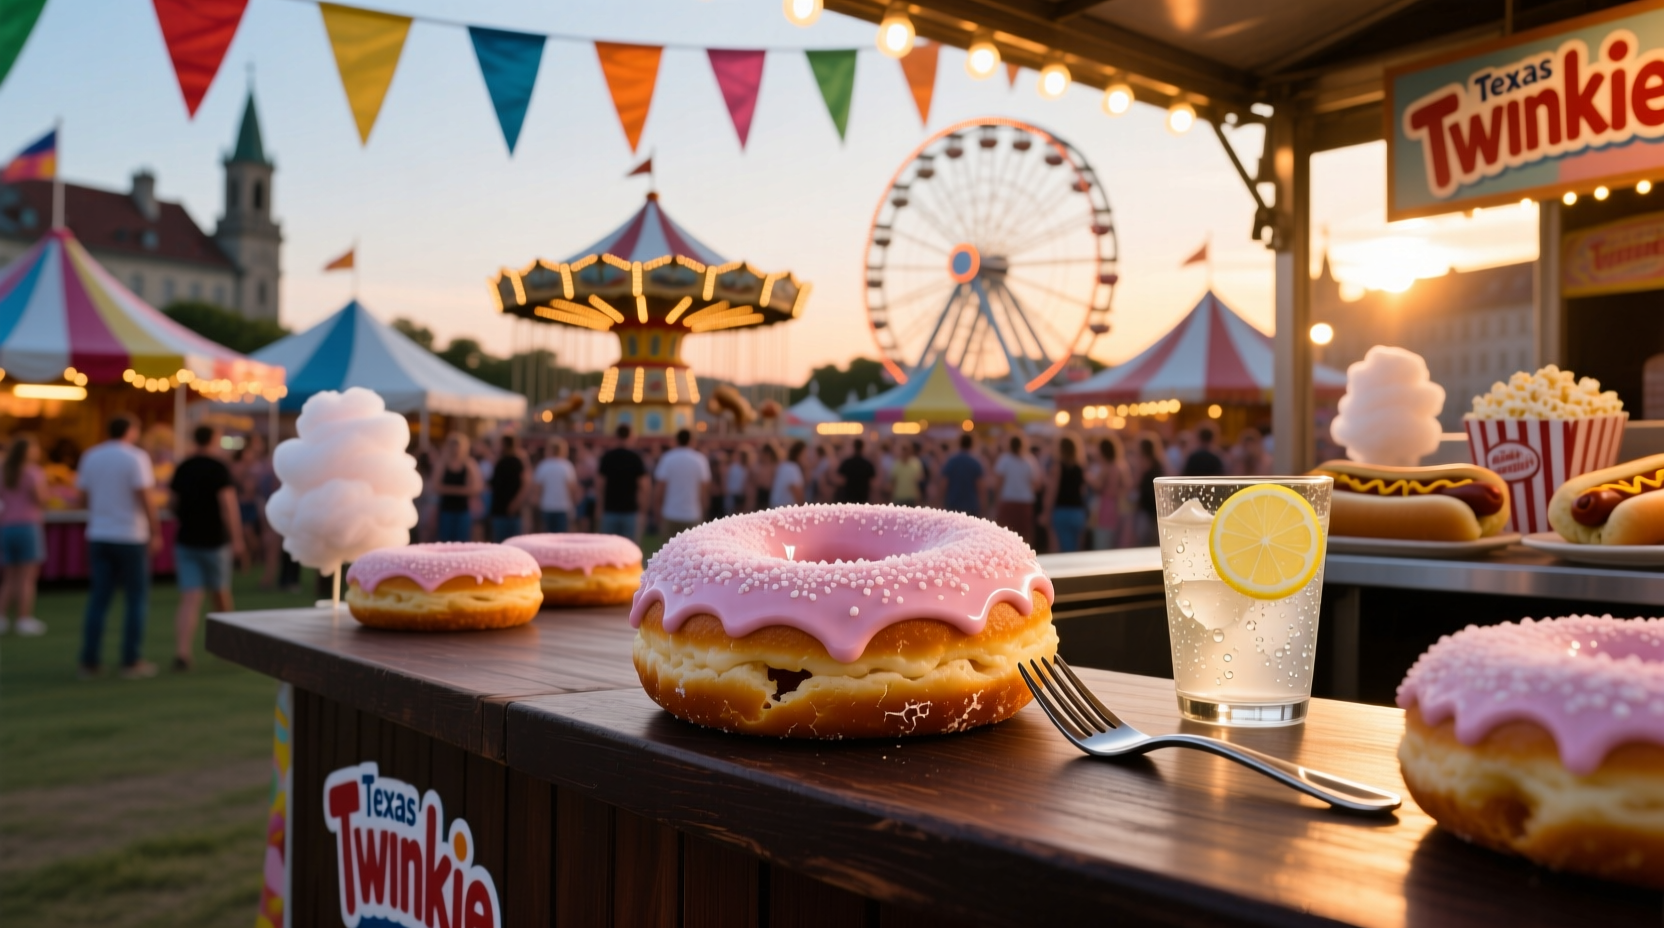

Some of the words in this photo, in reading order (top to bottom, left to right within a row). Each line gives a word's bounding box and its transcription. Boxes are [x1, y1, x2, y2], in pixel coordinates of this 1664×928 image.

[1410, 40, 1664, 189] Twinkie
[1474, 58, 1553, 102] Texas
[362, 774, 417, 827] Texas
[329, 780, 495, 928] Twinkie
